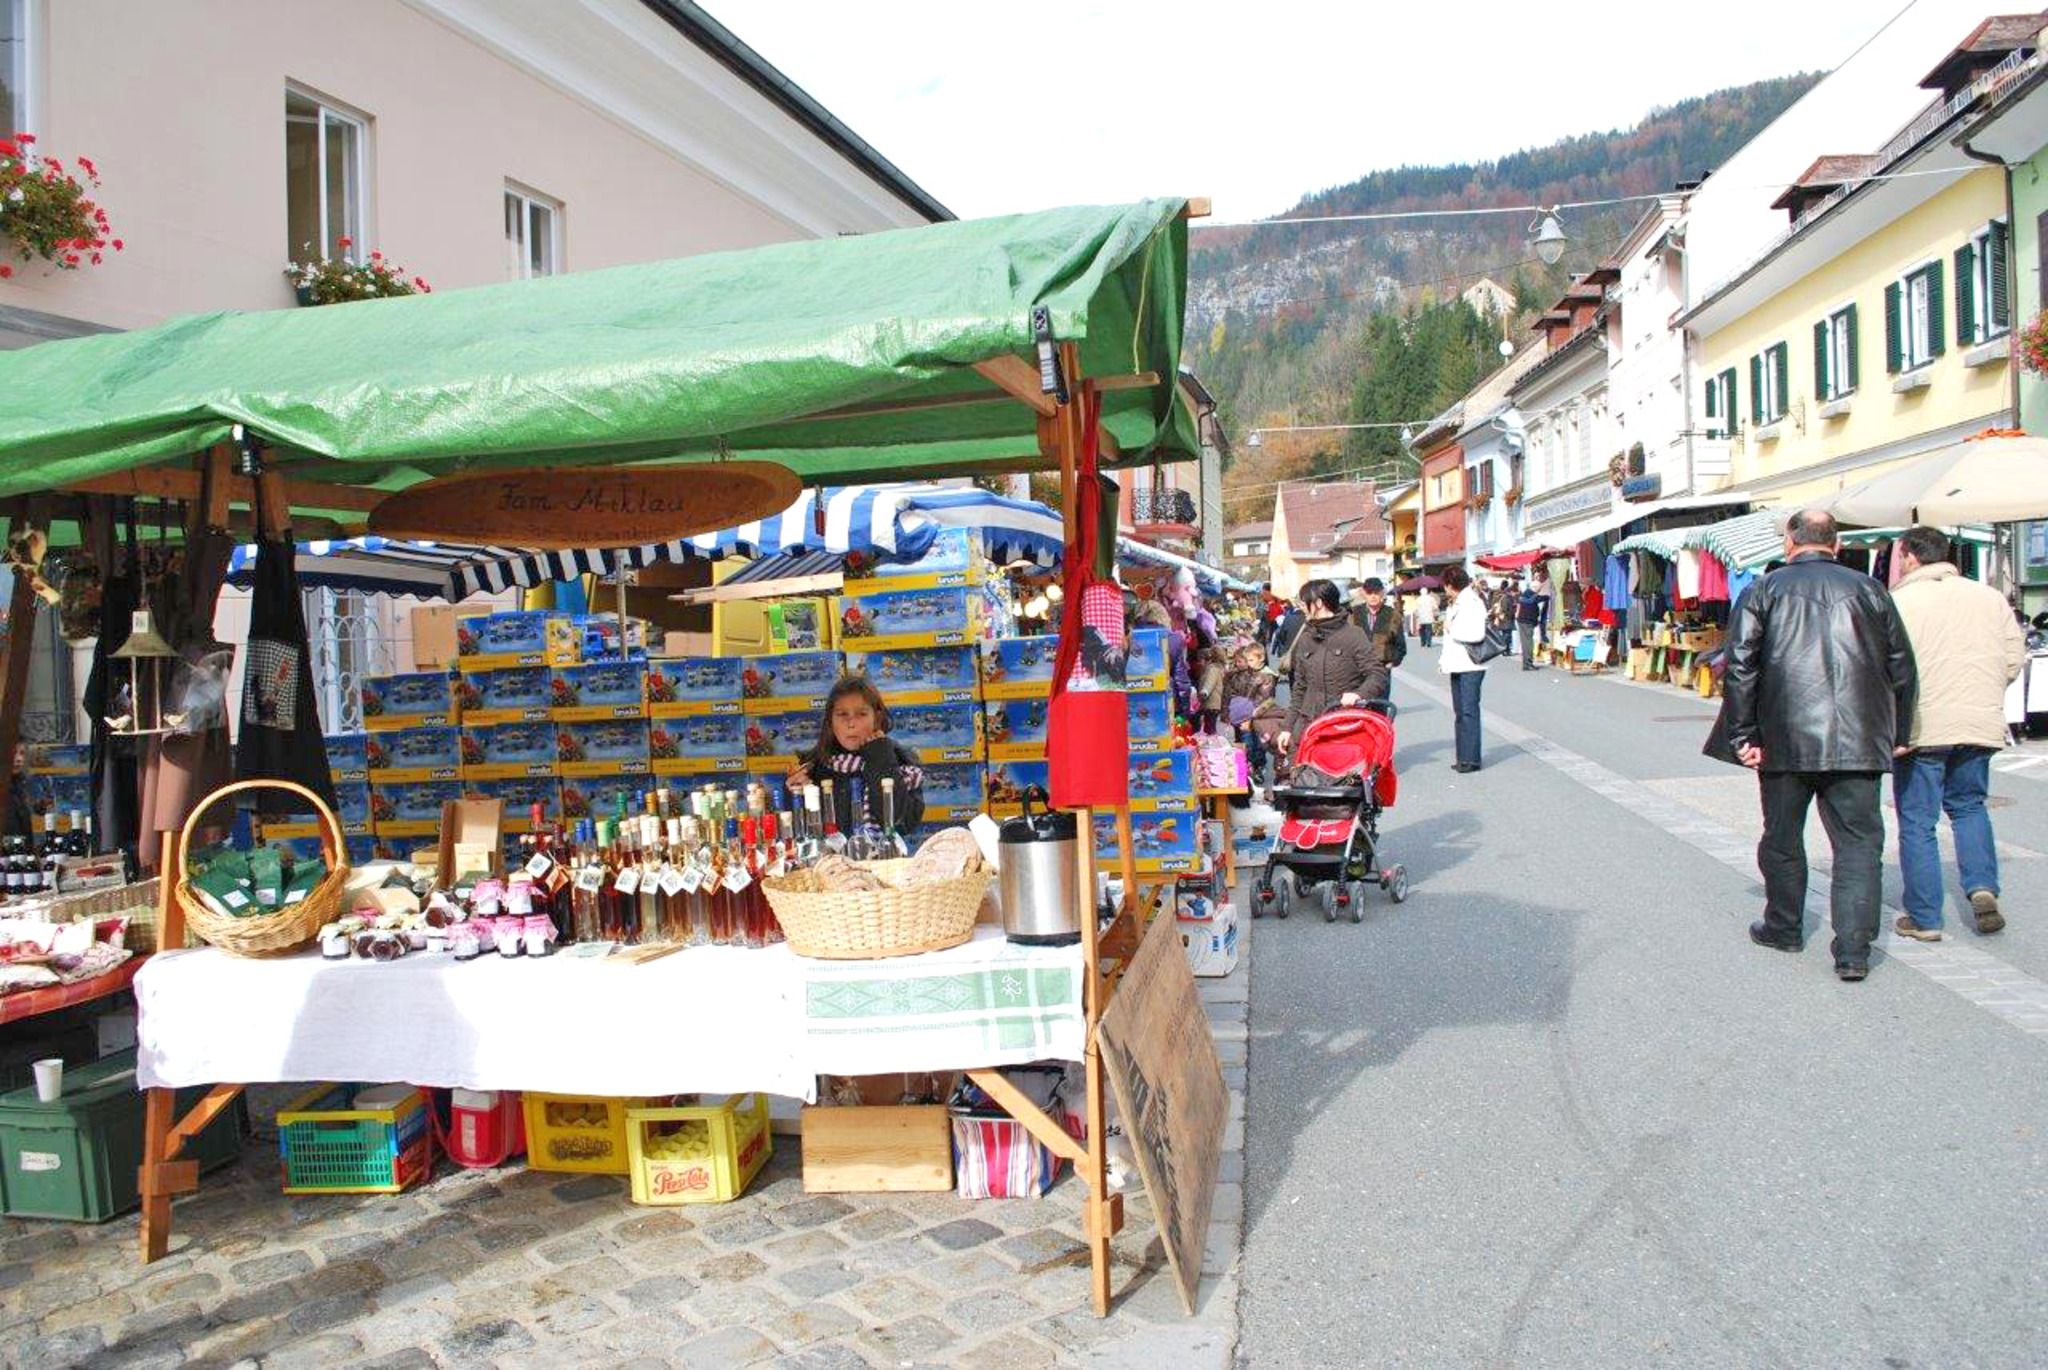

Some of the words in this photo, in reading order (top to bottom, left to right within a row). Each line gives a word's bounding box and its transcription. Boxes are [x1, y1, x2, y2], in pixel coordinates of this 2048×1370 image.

[935, 632, 963, 642] bruder
[945, 691, 972, 700] bruder
[713, 703, 738, 712] bruder
[945, 751, 972, 760] bruder
[717, 759, 744, 768] bruder
[1156, 800, 1186, 810] bruder
[1160, 859, 1190, 870] bruder
